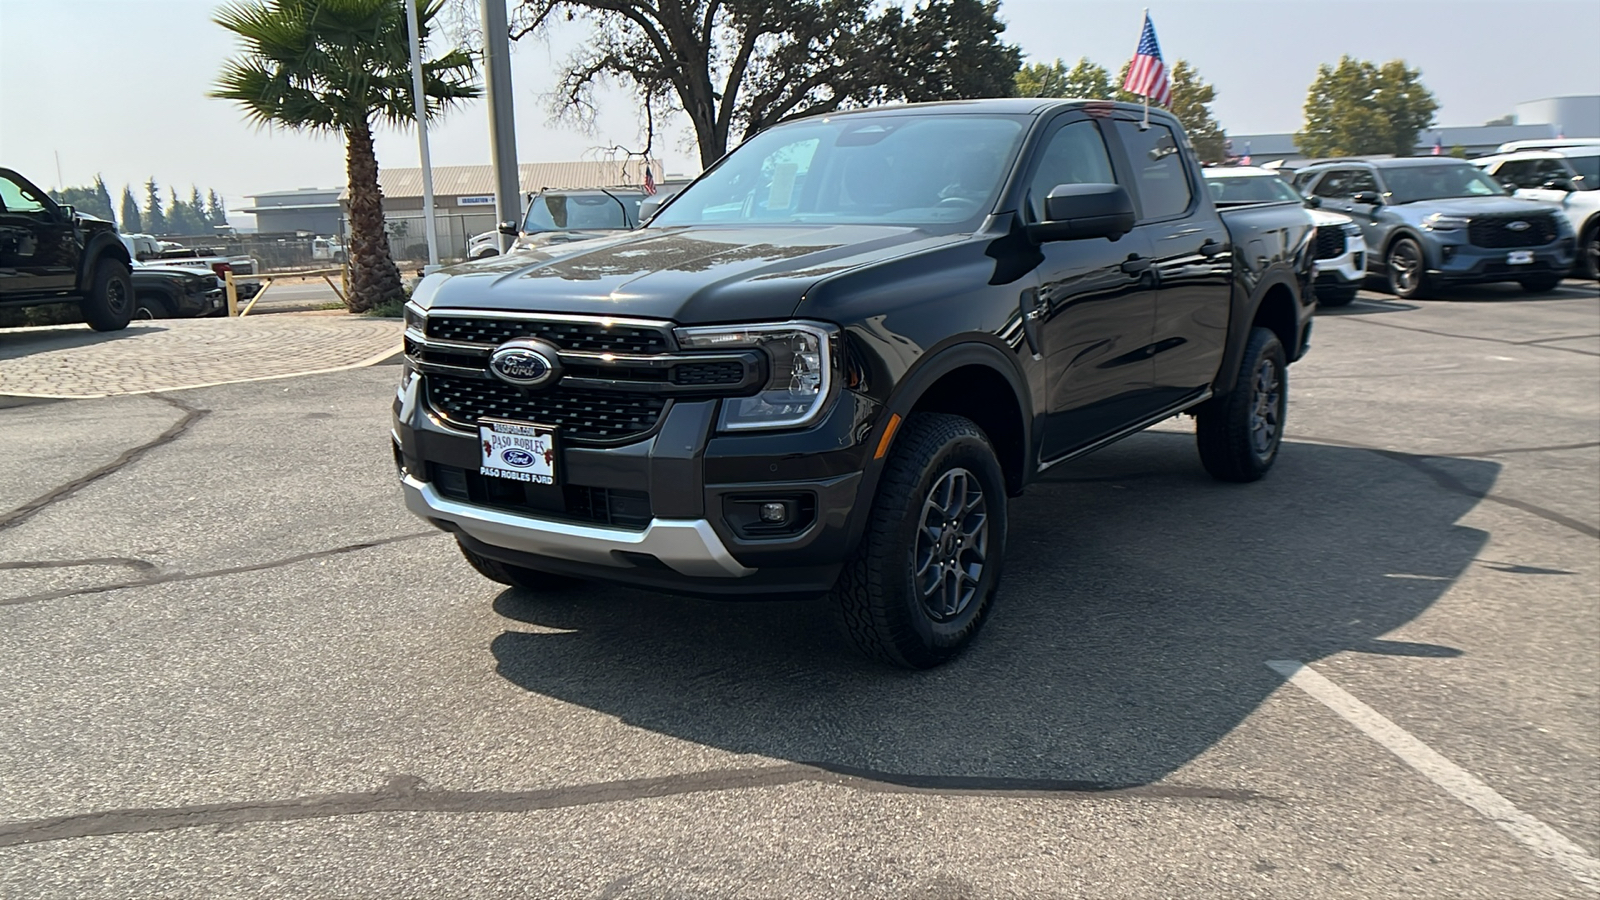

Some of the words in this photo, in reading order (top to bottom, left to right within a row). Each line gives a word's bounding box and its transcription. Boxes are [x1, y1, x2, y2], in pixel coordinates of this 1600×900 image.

[502, 355, 535, 376] Ford
[491, 434, 511, 450] PASO
[513, 437, 545, 456] ROBLES
[507, 452, 529, 465] Ford
[480, 466, 500, 478] PASO
[501, 470, 531, 482] ROBLES
[532, 474, 553, 485] FORD
